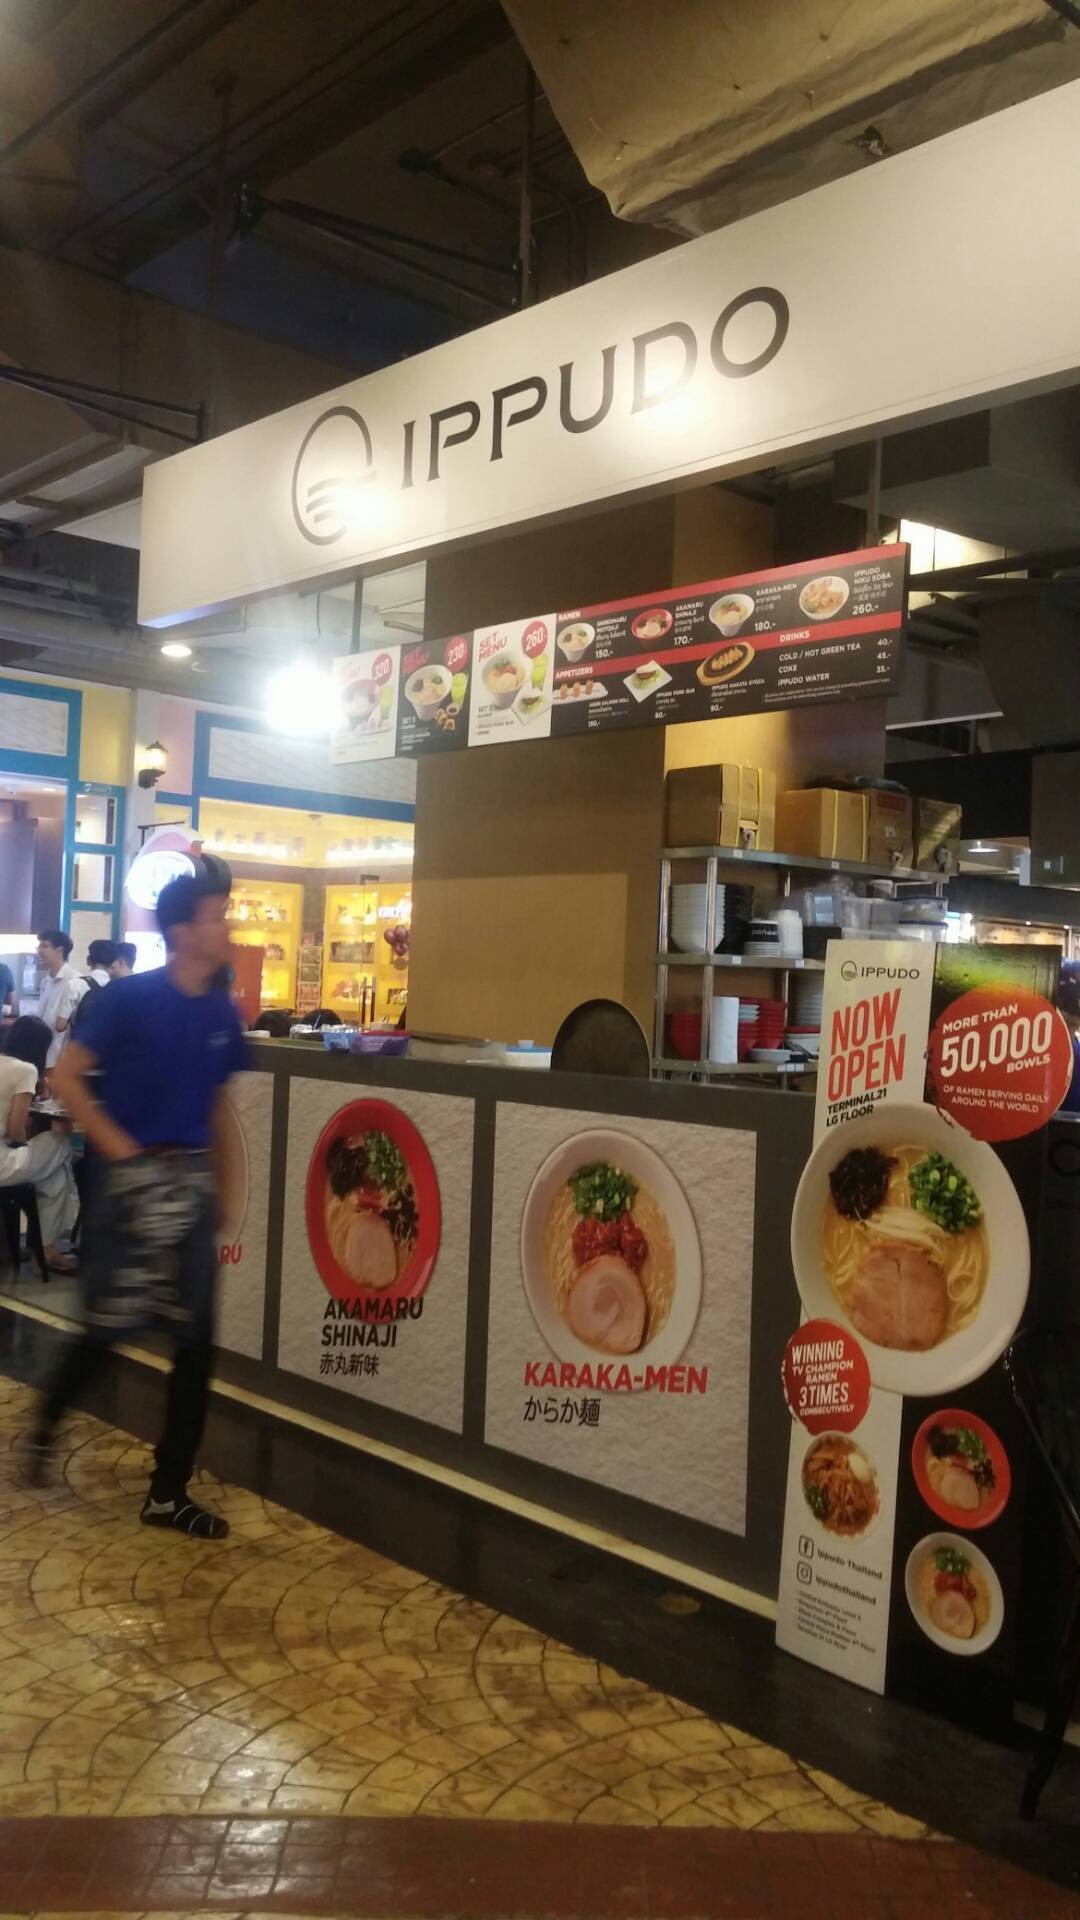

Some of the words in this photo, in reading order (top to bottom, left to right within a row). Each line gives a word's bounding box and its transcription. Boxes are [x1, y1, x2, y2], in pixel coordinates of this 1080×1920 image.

[401, 286, 790, 489] IPPUDO
[853, 567, 881, 578] IPPUDO
[756, 584, 798, 596] KARAKA-MEN
[558, 611, 581, 621] RAMEN
[780, 630, 810, 643] DRINKS
[779, 651, 798, 662] COLD
[804, 648, 820, 657] HOT
[820, 645, 846, 655] GREEN
[846, 642, 861, 650] TEA
[555, 666, 593, 679] APPETIZERS
[778, 664, 798, 673] COKE
[778, 674, 804, 687] IPPUDO
[805, 673, 830, 682] WATER
[861, 967, 920, 980] IPPUDO
[831, 988, 902, 1056] NOW
[942, 1016, 979, 1034] MORE
[981, 1004, 1019, 1023] THAN
[940, 1011, 1053, 1078] 50,000
[827, 1034, 906, 1102] OPEN
[1006, 1054, 1051, 1074] BOWLS
[943, 1084, 954, 1094] OF
[956, 1086, 986, 1097] RAMEN
[987, 1089, 1023, 1100] SERVING
[1024, 1092, 1049, 1104] DAILY
[951, 1096, 986, 1108] AROUND
[988, 1098, 1005, 1109] THE
[1006, 1101, 1039, 1113] WORLD
[826, 1114, 838, 1127] LG
[840, 1105, 874, 1123] FLOOR
[323, 1297, 424, 1320] AKAMARU
[320, 1324, 397, 1347] SHINAJI
[792, 1340, 844, 1365] WINNING
[319, 1352, 380, 1377] 赤丸新味
[792, 1366, 804, 1376] TV
[805, 1360, 854, 1374] CHAMPION
[524, 1362, 709, 1394] KARAKA-MEN
[805, 1371, 837, 1385] RAMEN
[523, 1395, 602, 1427] からか麺
[800, 1404, 855, 1416] CONSECUTIVELY
[847, 1560, 883, 1580] Thailand
